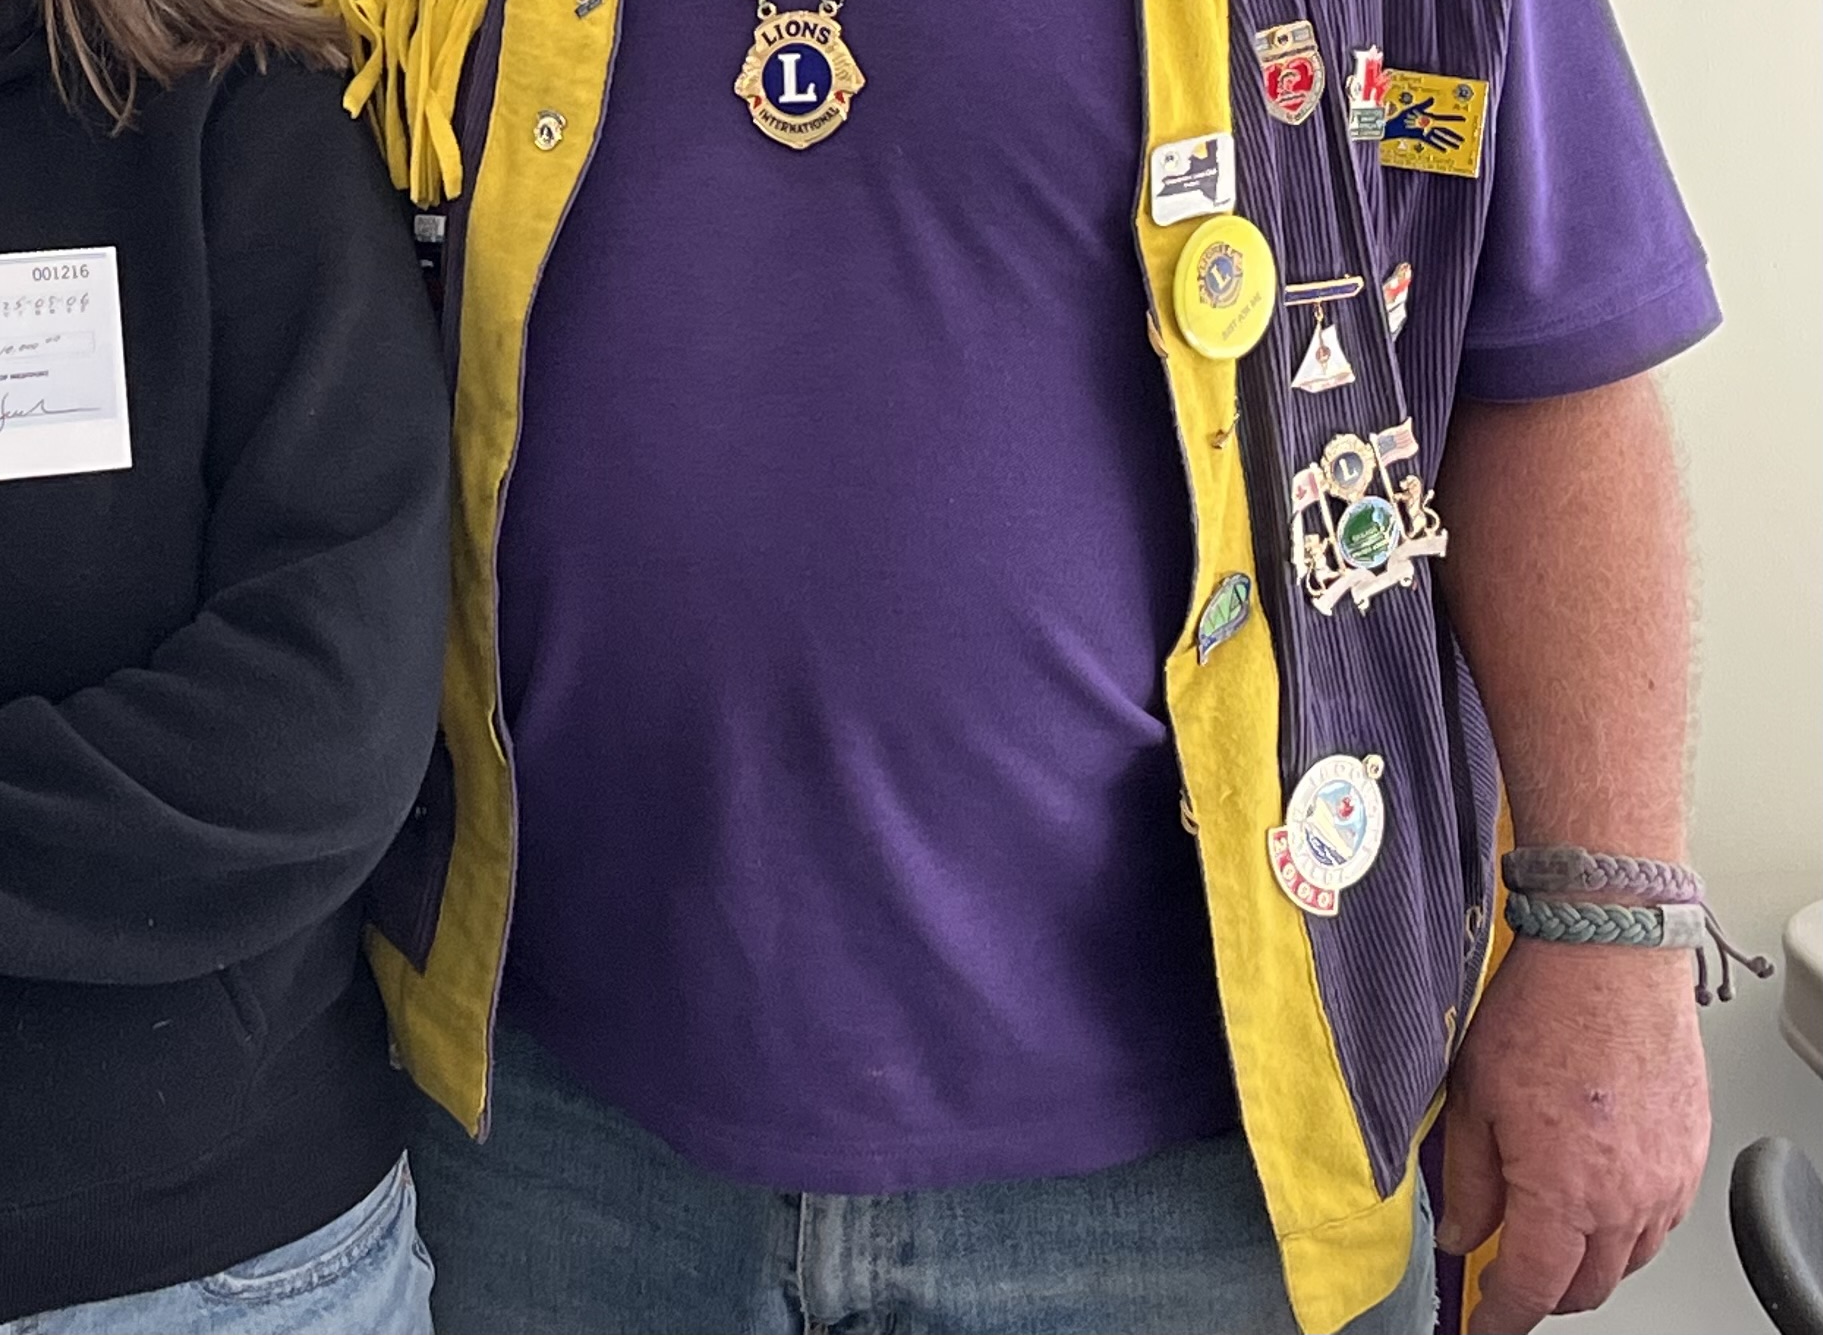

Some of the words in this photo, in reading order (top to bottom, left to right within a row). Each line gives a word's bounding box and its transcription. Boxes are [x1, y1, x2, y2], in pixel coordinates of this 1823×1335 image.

[761, 20, 832, 47] LIONS
[778, 52, 818, 104] L
[758, 106, 841, 134] INTERNATIONAL
[31, 264, 91, 282] 001216
